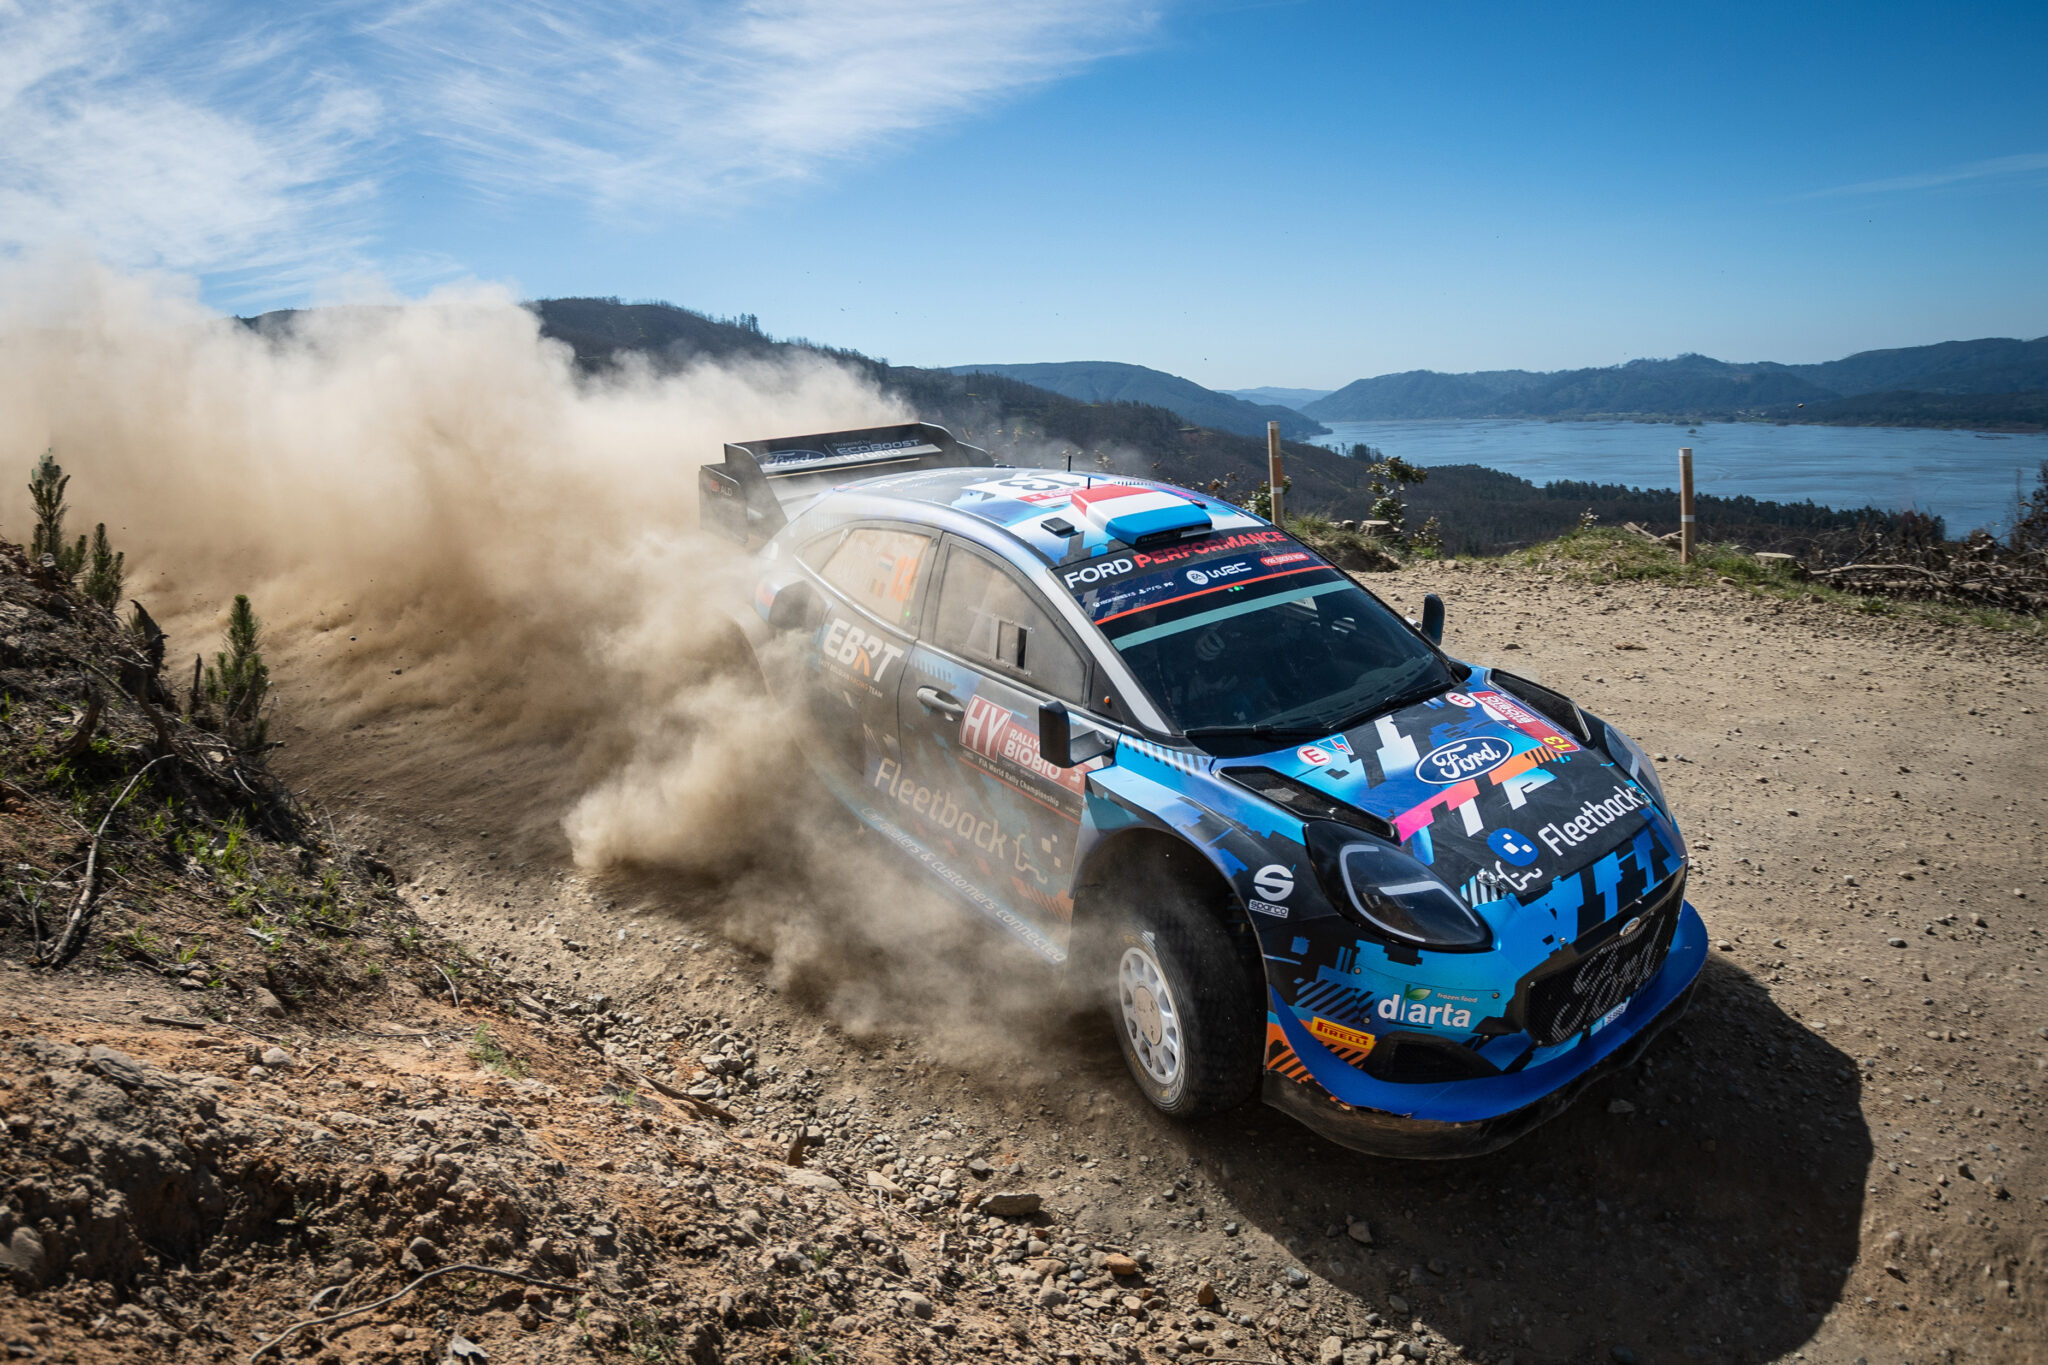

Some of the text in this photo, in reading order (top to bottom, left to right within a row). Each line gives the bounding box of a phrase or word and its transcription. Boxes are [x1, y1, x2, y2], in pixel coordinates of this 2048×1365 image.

[764, 452, 812, 467] Ford
[837, 439, 920, 455] ECOBOOST
[1064, 530, 1288, 589] FORD PERFORMANCE
[1205, 562, 1252, 579] WRC
[889, 554, 917, 604] 13
[822, 617, 904, 683] EBRT
[1451, 694, 1471, 706] E
[962, 699, 1011, 757] HY
[1009, 728, 1040, 750] RALLY
[1543, 735, 1571, 751] 13
[1302, 748, 1327, 765] E
[1432, 742, 1503, 779] Ford
[978, 757, 988, 769] FIA
[989, 763, 1005, 778] World
[1005, 771, 1020, 787] Rally
[1019, 779, 1060, 808] Championship
[874, 757, 1008, 860] Fleetback
[1538, 785, 1644, 857] Fleetback
[860, 807, 883, 826] Car
[919, 851, 935, 863] &
[930, 860, 1000, 912] customers
[995, 905, 1069, 964] connected
[1250, 900, 1288, 915] sparco
[1437, 992, 1478, 1004] frozen food
[1316, 1021, 1369, 1047] PIRELLI
